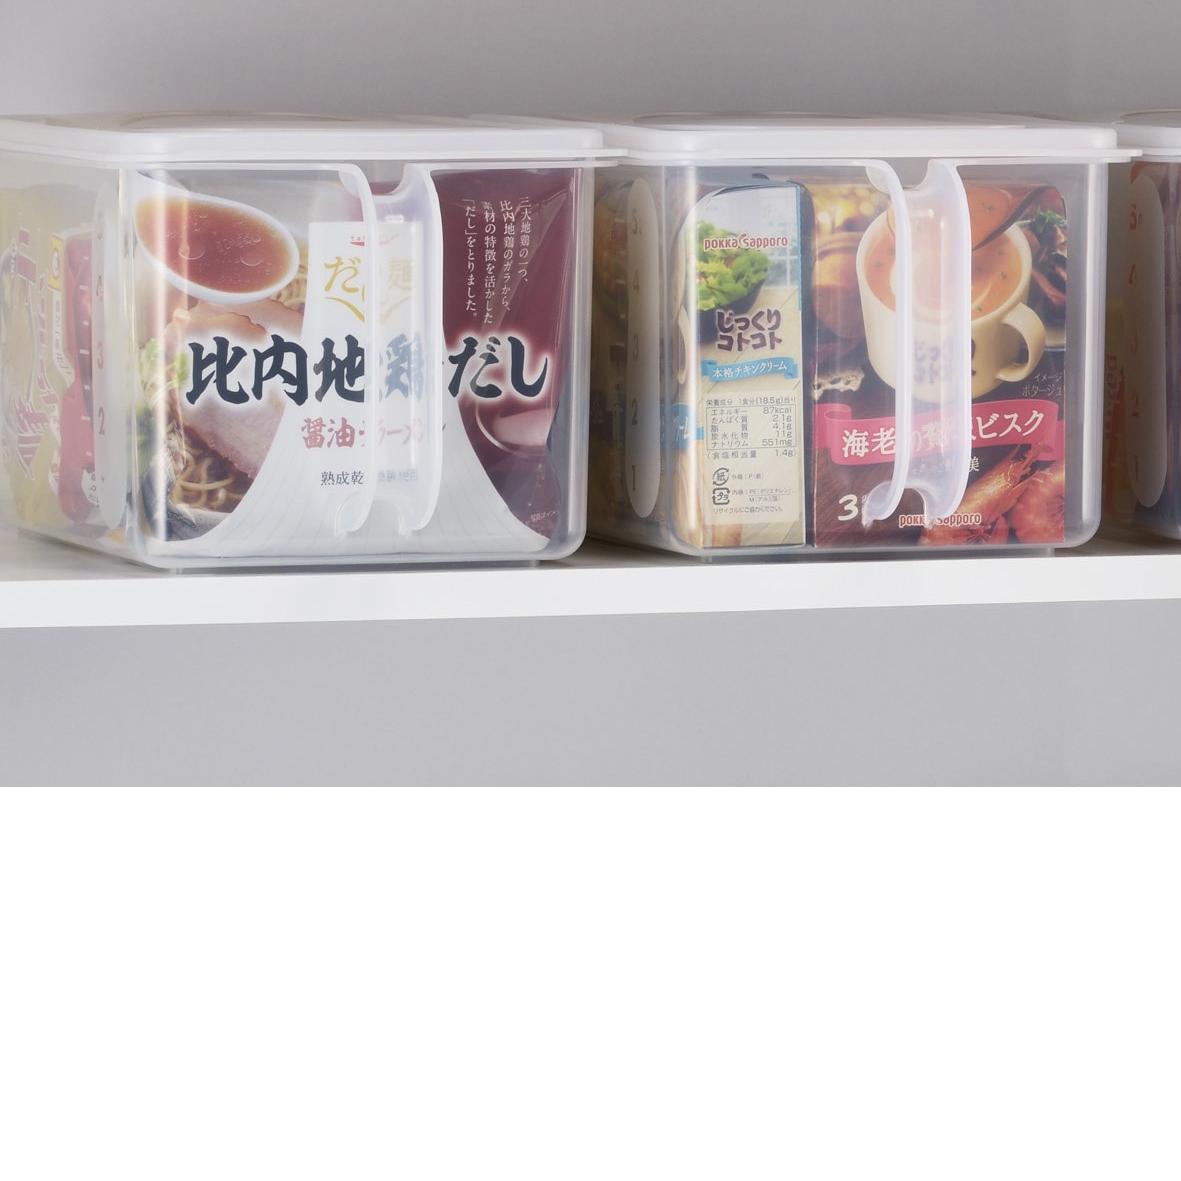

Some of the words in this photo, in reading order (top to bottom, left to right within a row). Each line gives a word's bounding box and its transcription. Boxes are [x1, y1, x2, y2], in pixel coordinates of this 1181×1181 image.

[716, 308, 782, 334] じっくり
[717, 331, 783, 352] コトコト
[713, 360, 787, 379] 本格チキンクリーム
[763, 406, 792, 414] 87kcal
[773, 414, 792, 423] 2.1g
[773, 422, 792, 430] 4.1g
[776, 430, 792, 438] 11g
[762, 438, 792, 447] 551mg
